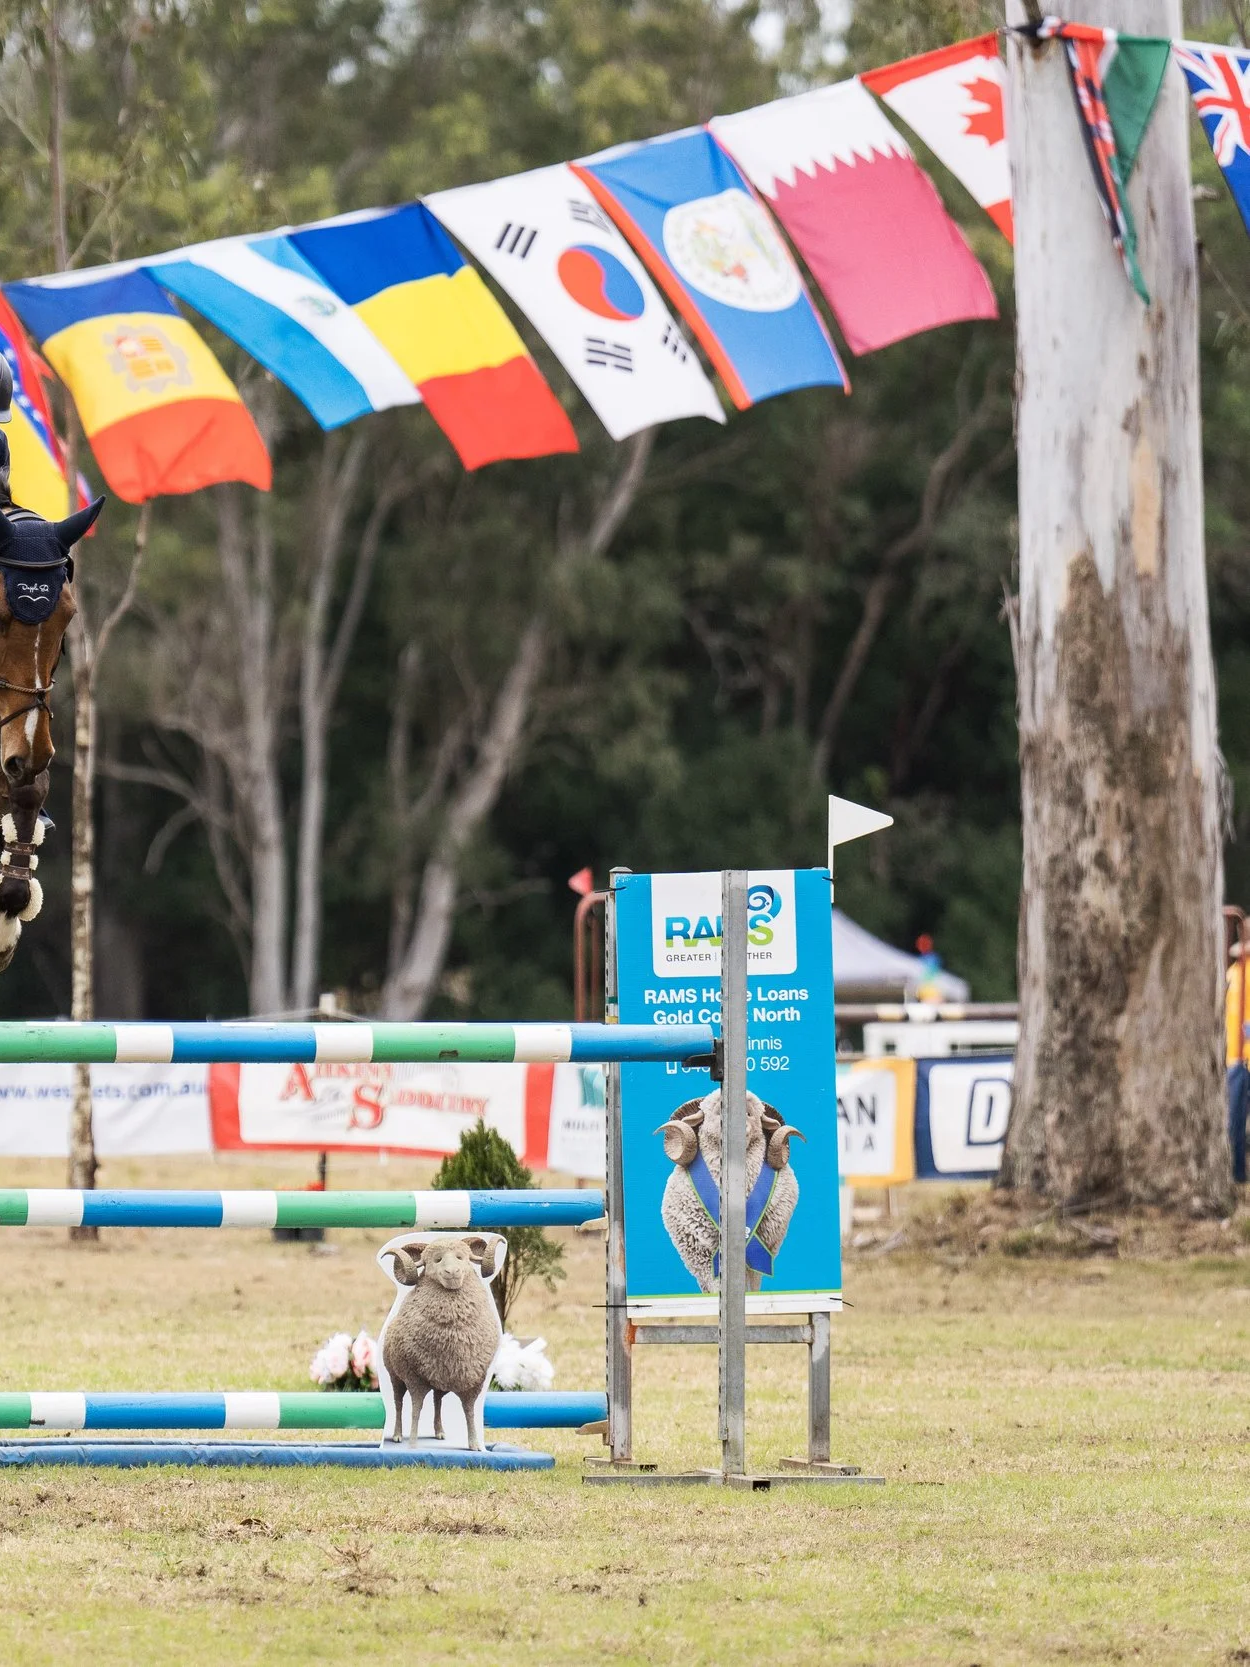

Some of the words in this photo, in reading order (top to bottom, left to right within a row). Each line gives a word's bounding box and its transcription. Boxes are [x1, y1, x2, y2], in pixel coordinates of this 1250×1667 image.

[665, 914, 774, 948] RAS
[666, 953, 711, 962] GREATER
[644, 989, 697, 1004] RAMS
[757, 987, 809, 1001] Loans
[653, 1010, 693, 1024] Gold
[753, 1007, 801, 1022] North
[760, 1056, 790, 1071] 592
